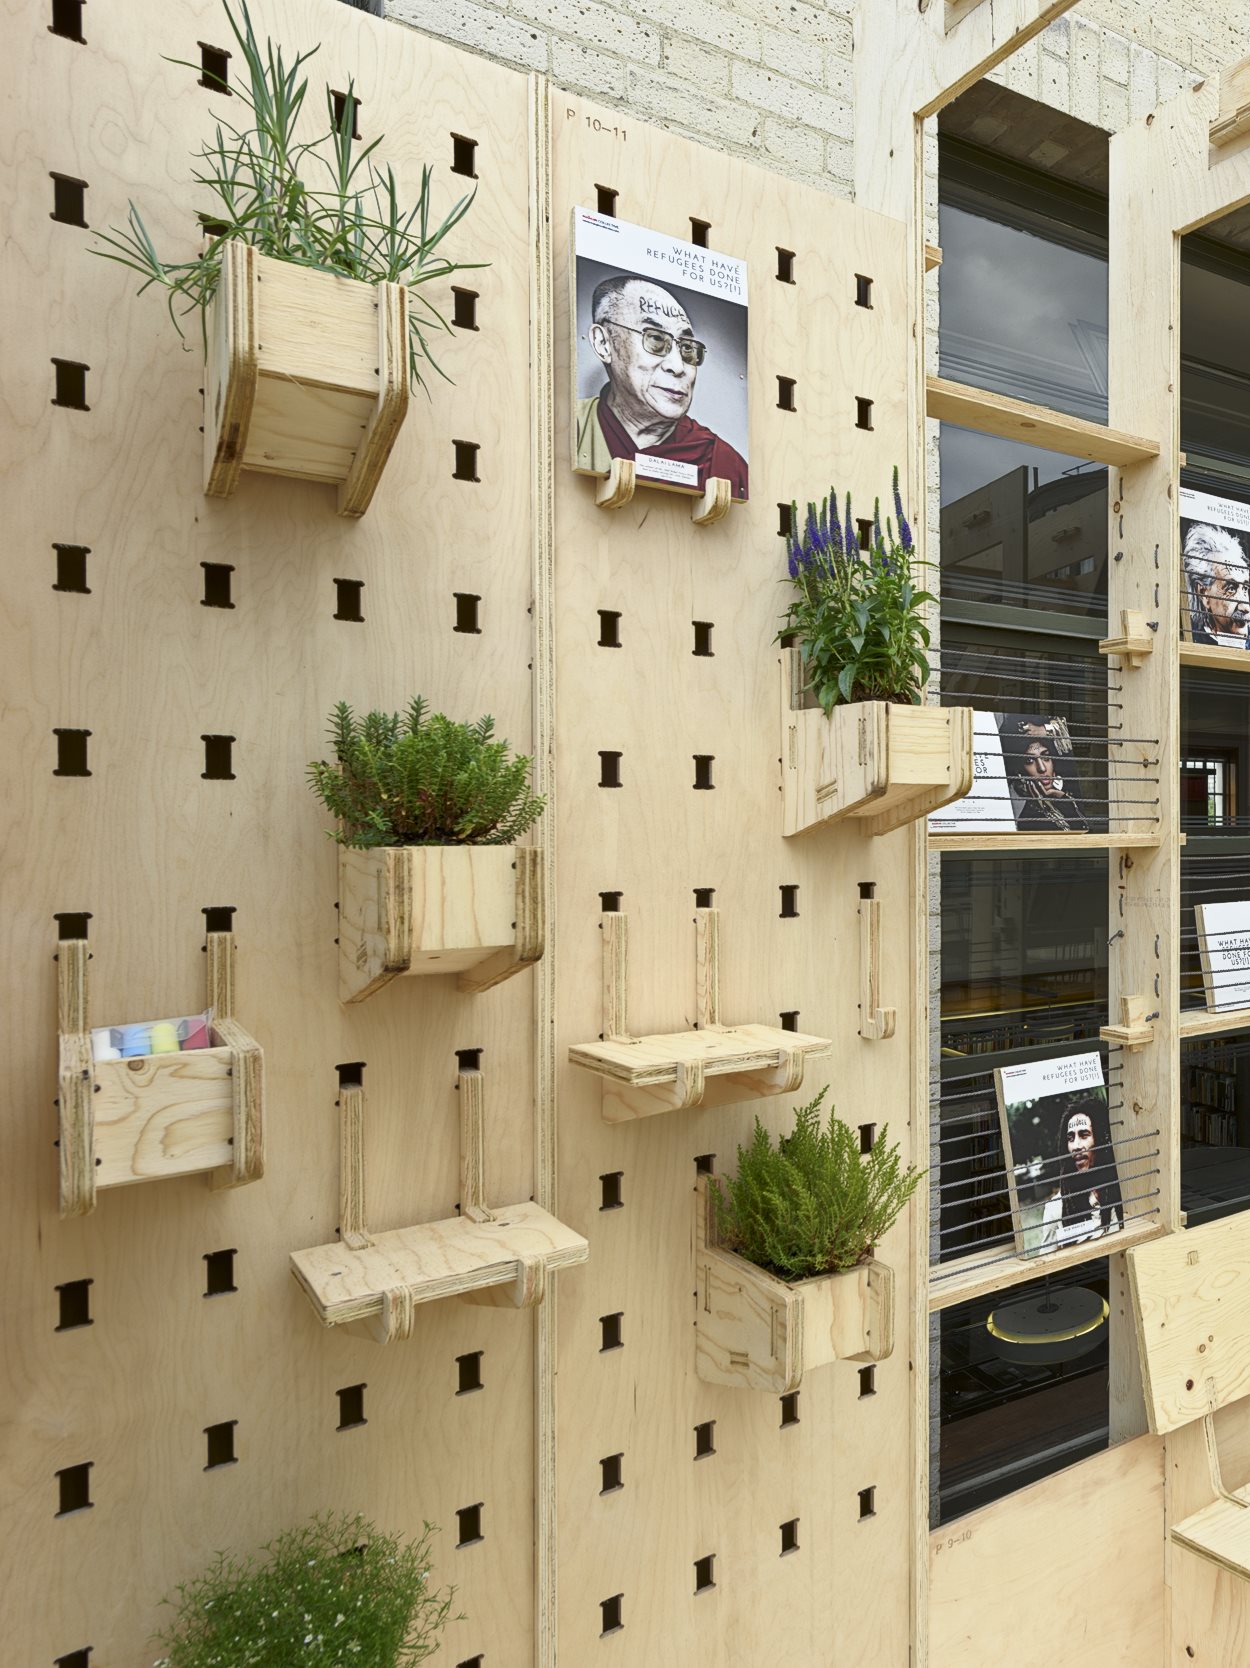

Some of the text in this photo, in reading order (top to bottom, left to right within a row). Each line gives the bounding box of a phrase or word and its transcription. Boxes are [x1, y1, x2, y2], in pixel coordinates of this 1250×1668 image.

[566, 107, 576, 120] P
[646, 248, 740, 285] REFUGEES DONE
[672, 246, 740, 275] WHAT HAVE
[682, 269, 704, 282] FOR
[1217, 938, 1237, 947] WHAT
[1222, 951, 1241, 960] DONE
[1057, 1058, 1096, 1070] WHAT HAVE
[1042, 1065, 1098, 1080] REFUGEES DONE
[1064, 1076, 1078, 1084] FOR
[935, 1543, 943, 1555] P
